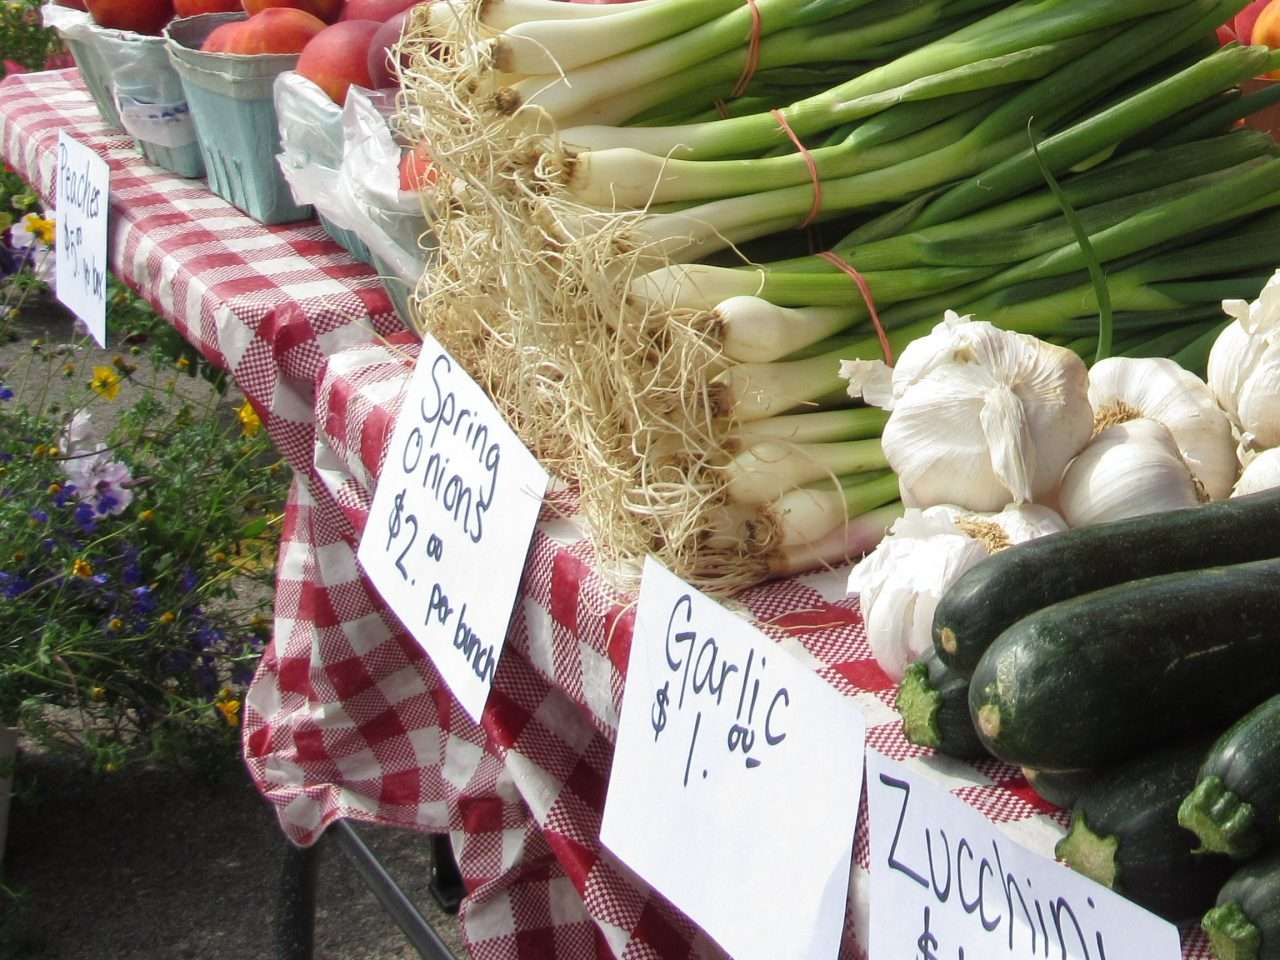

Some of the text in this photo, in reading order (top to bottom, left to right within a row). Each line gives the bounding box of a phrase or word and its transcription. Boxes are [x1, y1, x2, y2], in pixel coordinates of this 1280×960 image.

[59, 142, 100, 220] Peaches
[403, 427, 489, 544] Onions
[421, 354, 501, 512] Spring
[424, 583, 496, 686] per bunch
[665, 593, 790, 747] Garlic
[879, 772, 1107, 960] Zucchini
